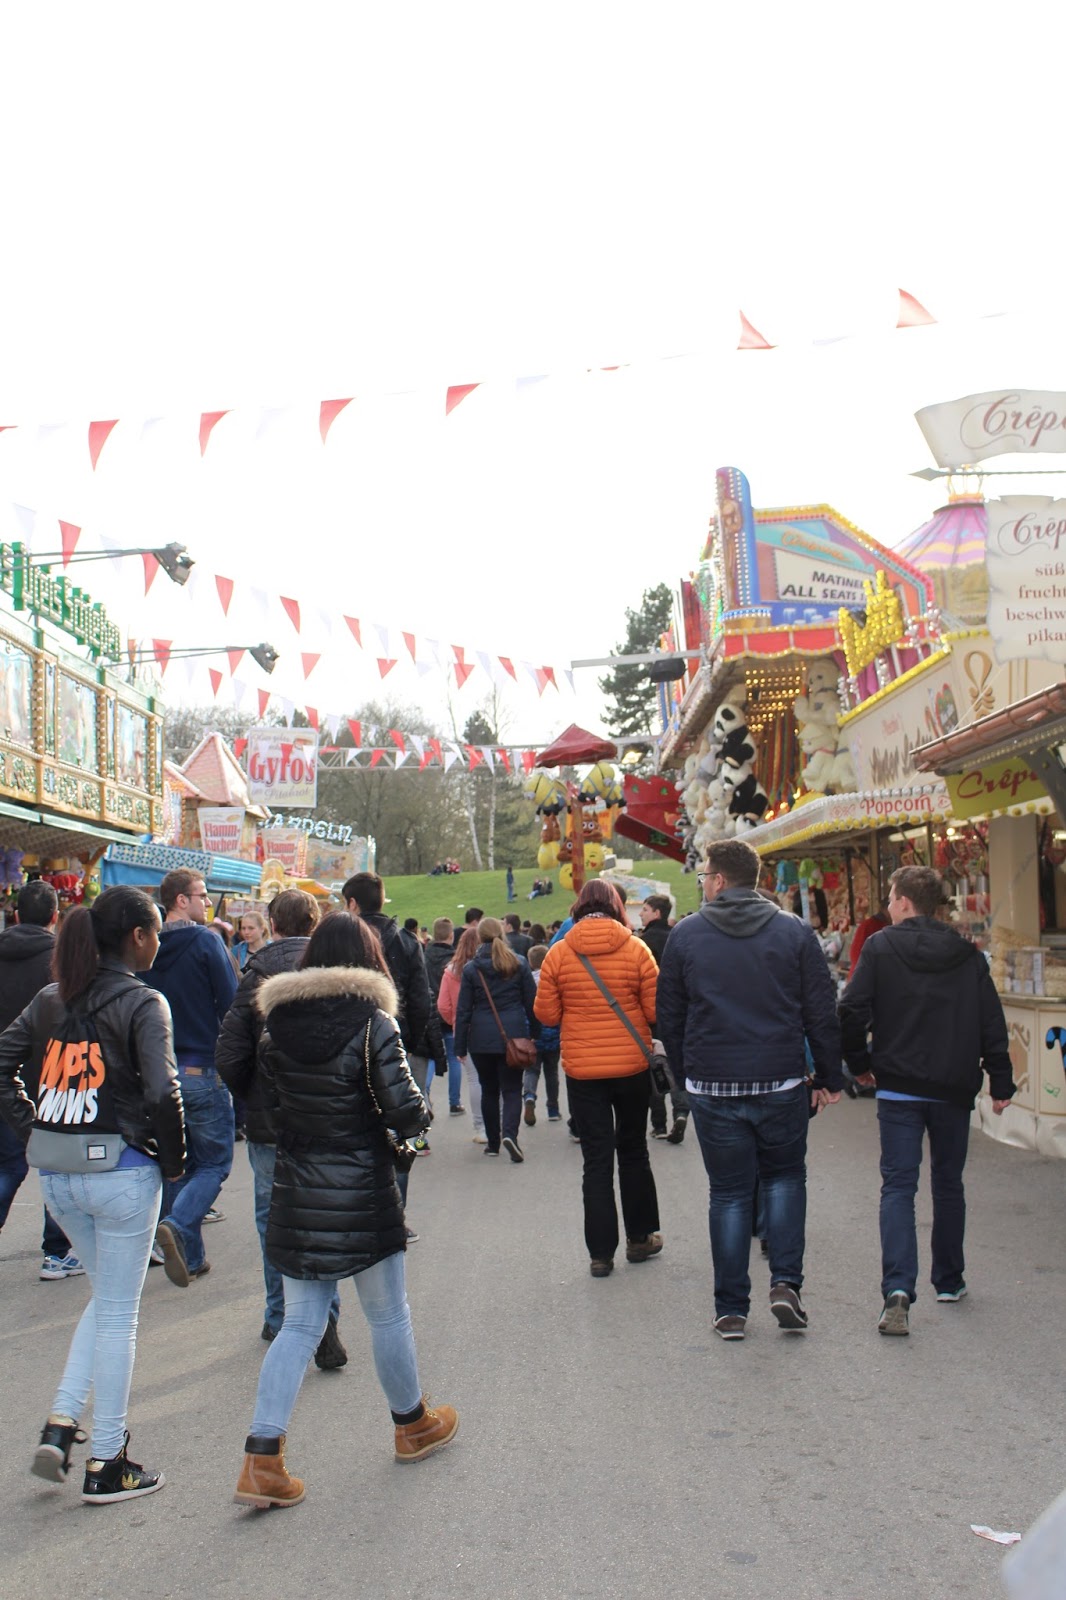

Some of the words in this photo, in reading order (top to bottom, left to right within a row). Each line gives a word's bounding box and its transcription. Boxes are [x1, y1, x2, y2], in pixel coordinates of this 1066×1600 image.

[1035, 561, 1066, 577] süß
[812, 571, 864, 588] MATINE
[782, 584, 817, 598] ALL
[822, 587, 857, 601] SEATS
[249, 752, 316, 788] Gyros
